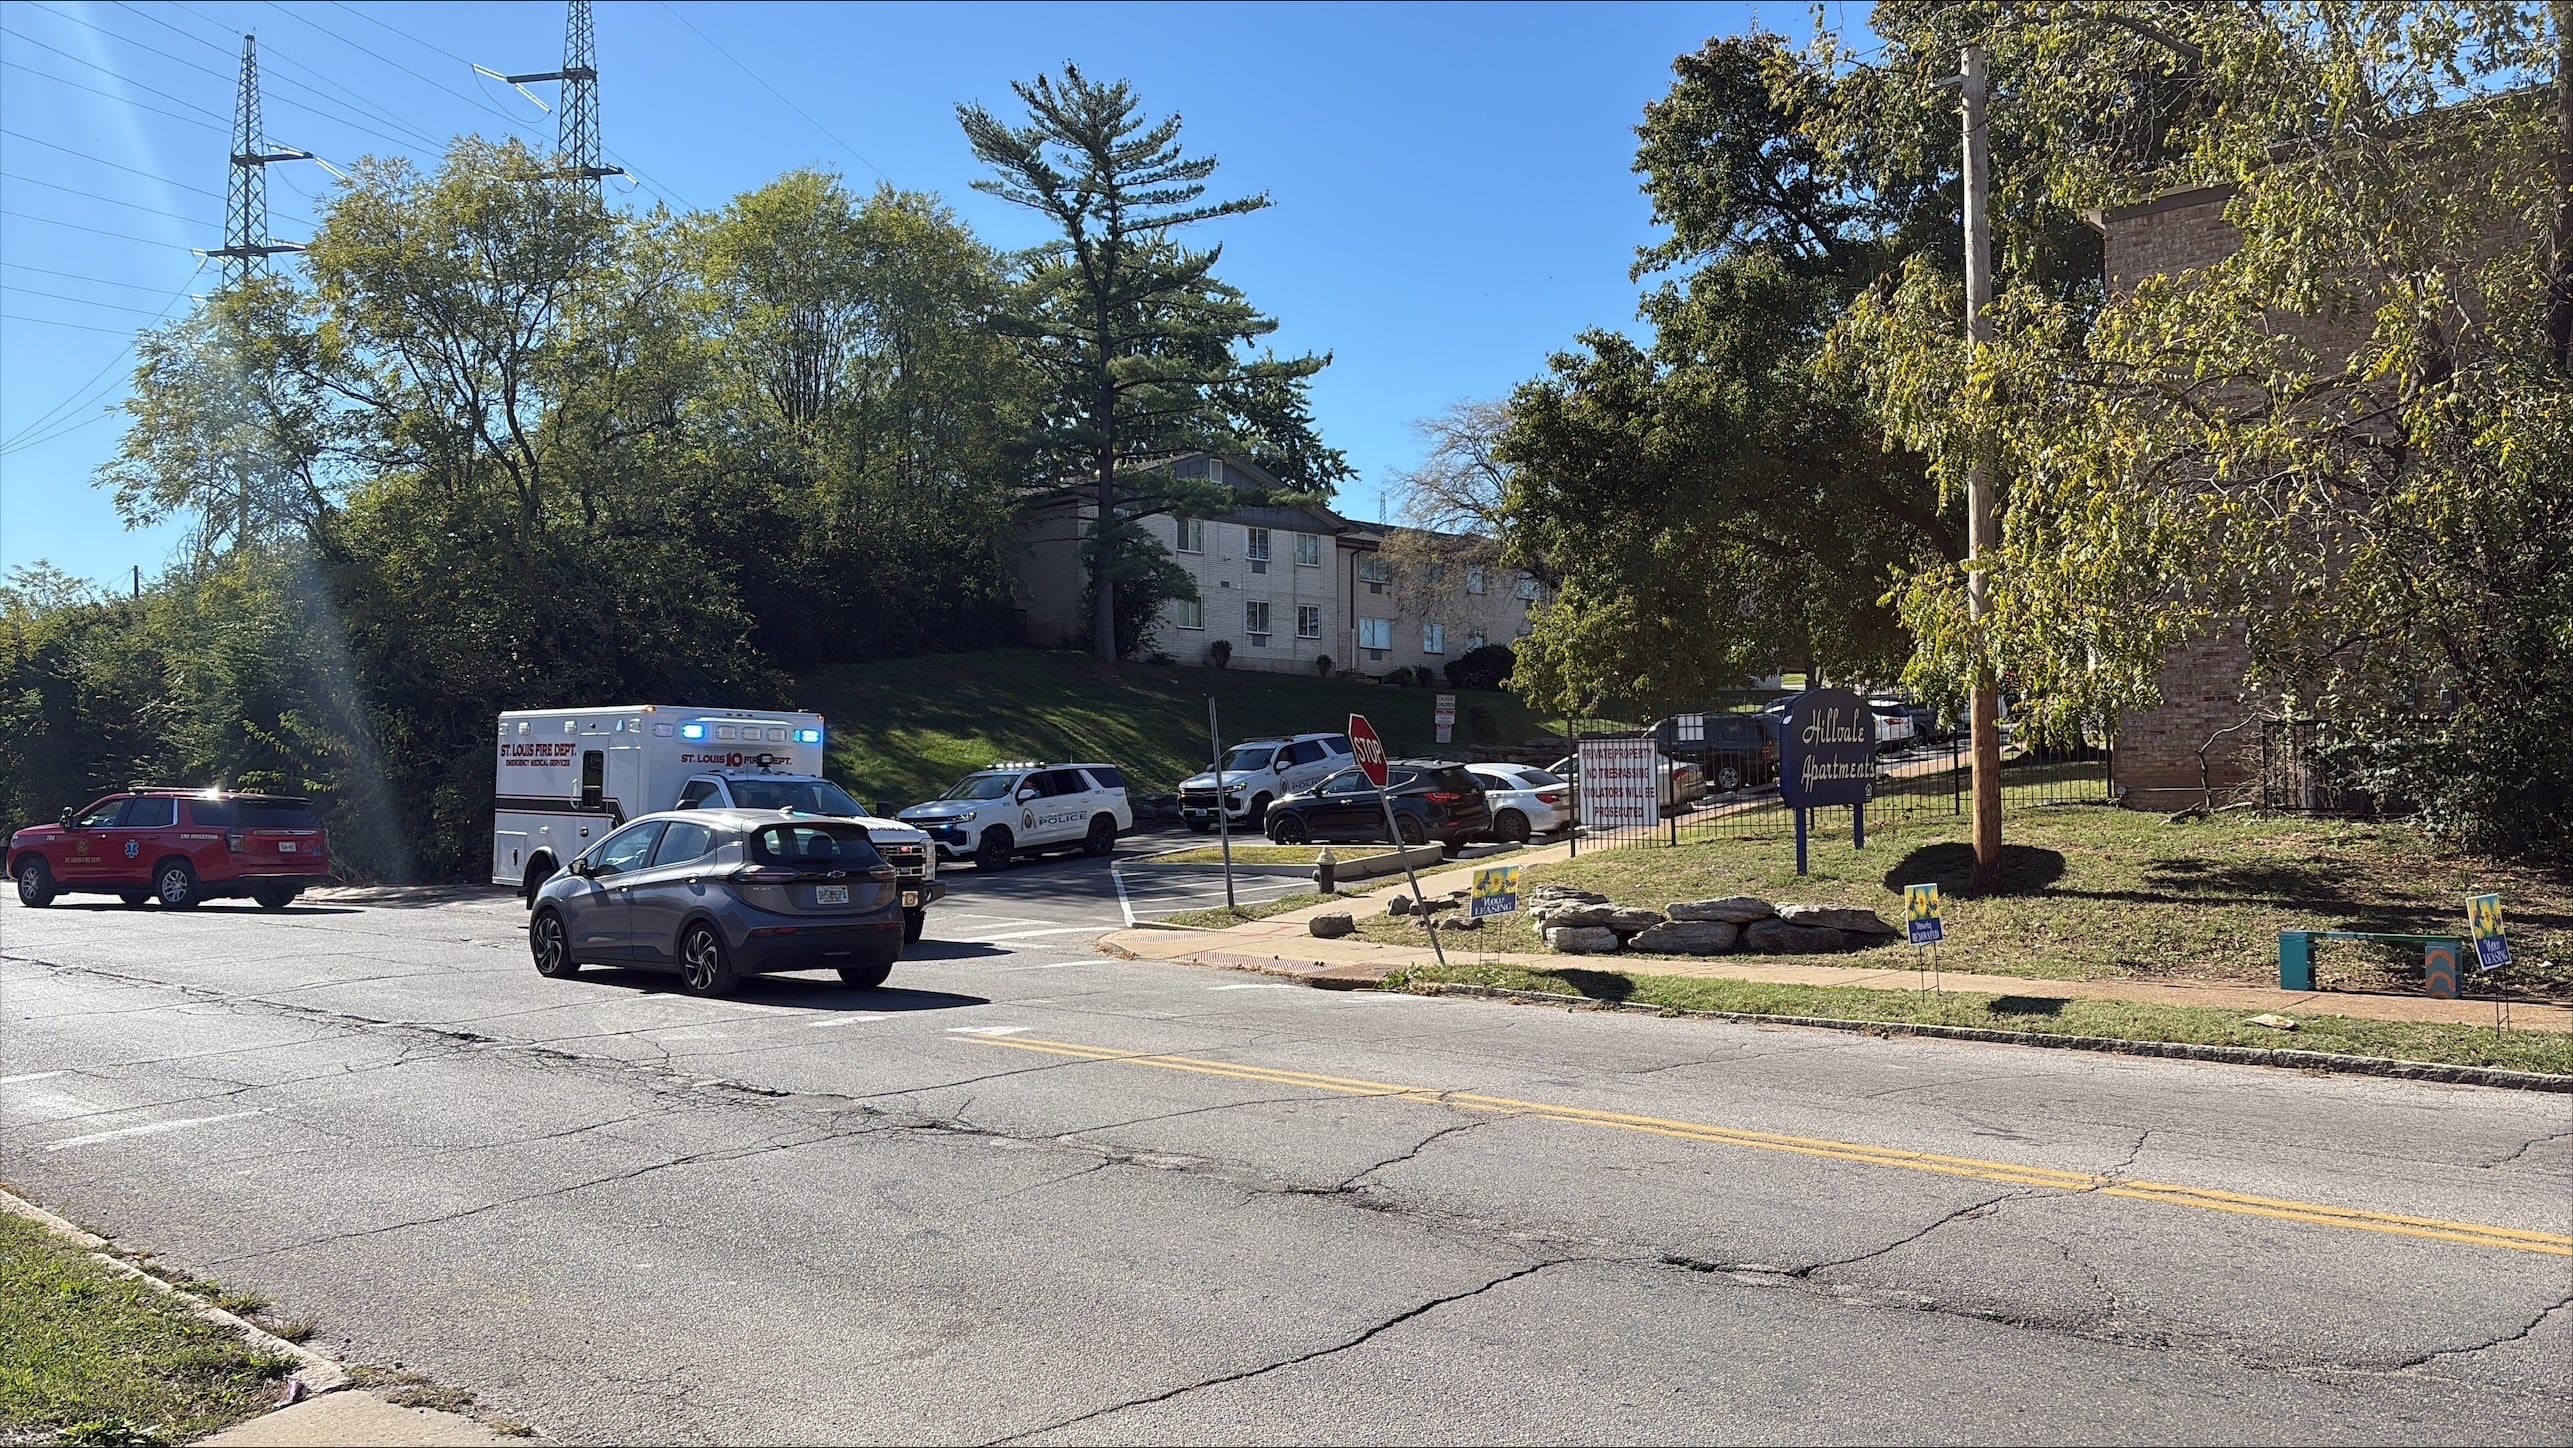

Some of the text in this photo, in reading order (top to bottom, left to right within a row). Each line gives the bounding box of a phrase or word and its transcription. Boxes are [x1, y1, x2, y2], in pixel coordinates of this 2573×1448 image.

[1802, 707, 1865, 747] Hillvale
[501, 742, 577, 757] ST. LOUIS FIRE DEPT.
[1354, 736, 1382, 765] STOP
[1582, 747, 1653, 760] PRIVATE PROPERTY
[681, 754, 725, 764] ST. LOUIS
[725, 752, 743, 767] 10
[743, 755, 792, 766] FIR EPT.
[1586, 767, 1649, 779] NO TRESPASSING
[1801, 753, 1876, 793] Apartments
[1582, 787, 1655, 798] VIOLATORS WILL BE
[1594, 806, 1644, 818] PROSECUTED
[1039, 814, 1087, 825] POLICE
[1475, 902, 1512, 916] LEASING
